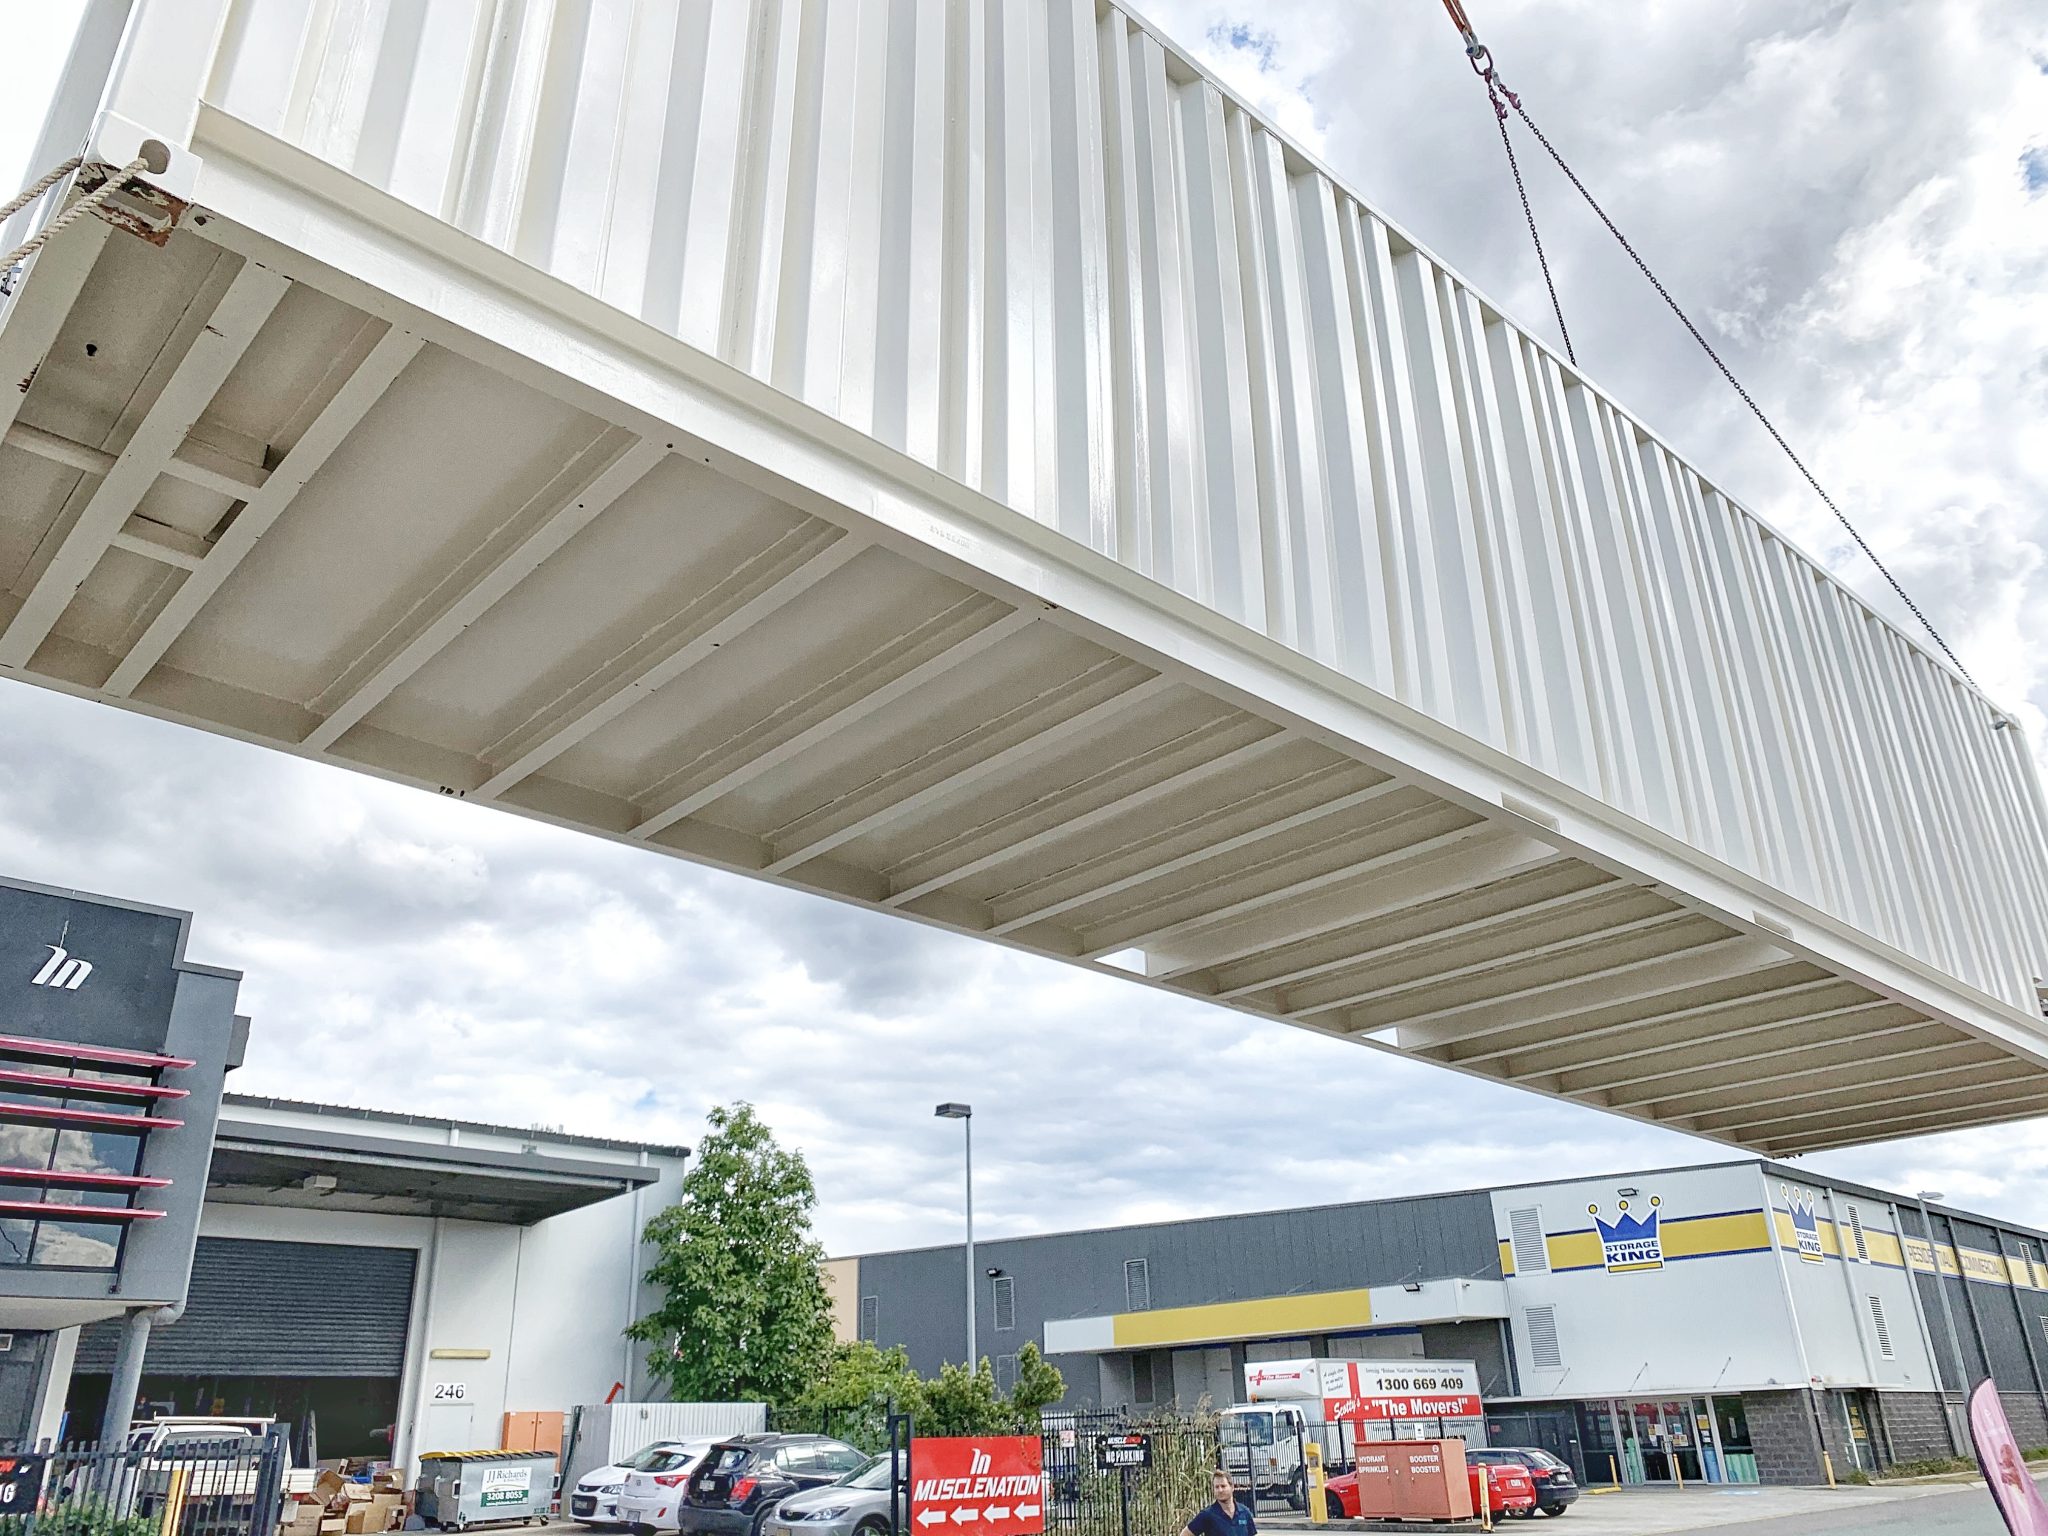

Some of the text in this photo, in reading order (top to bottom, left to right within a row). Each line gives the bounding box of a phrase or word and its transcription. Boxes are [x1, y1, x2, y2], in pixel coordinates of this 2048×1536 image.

[1796, 1231, 1819, 1241] STORAGE
[1605, 1240, 1659, 1252] STORAGE
[1799, 1240, 1821, 1252] KING
[1606, 1249, 1660, 1263] KING
[1377, 1377, 1463, 1391] 1300 669 409
[434, 1384, 464, 1399] 246
[1333, 1394, 1360, 1419] Scotty's
[1372, 1399, 1407, 1416] "The
[1410, 1397, 1468, 1415] Movers!"
[1116, 1449, 1144, 1463] PARKING
[1359, 1455, 1439, 1463] HYDRANT BOOSTER
[496, 1469, 528, 1479] Richards
[1359, 1465, 1440, 1474] SPRINKLER BOOSTER
[913, 1474, 1040, 1501] MUSCLENATION
[487, 1490, 523, 1501] 3208 8055
